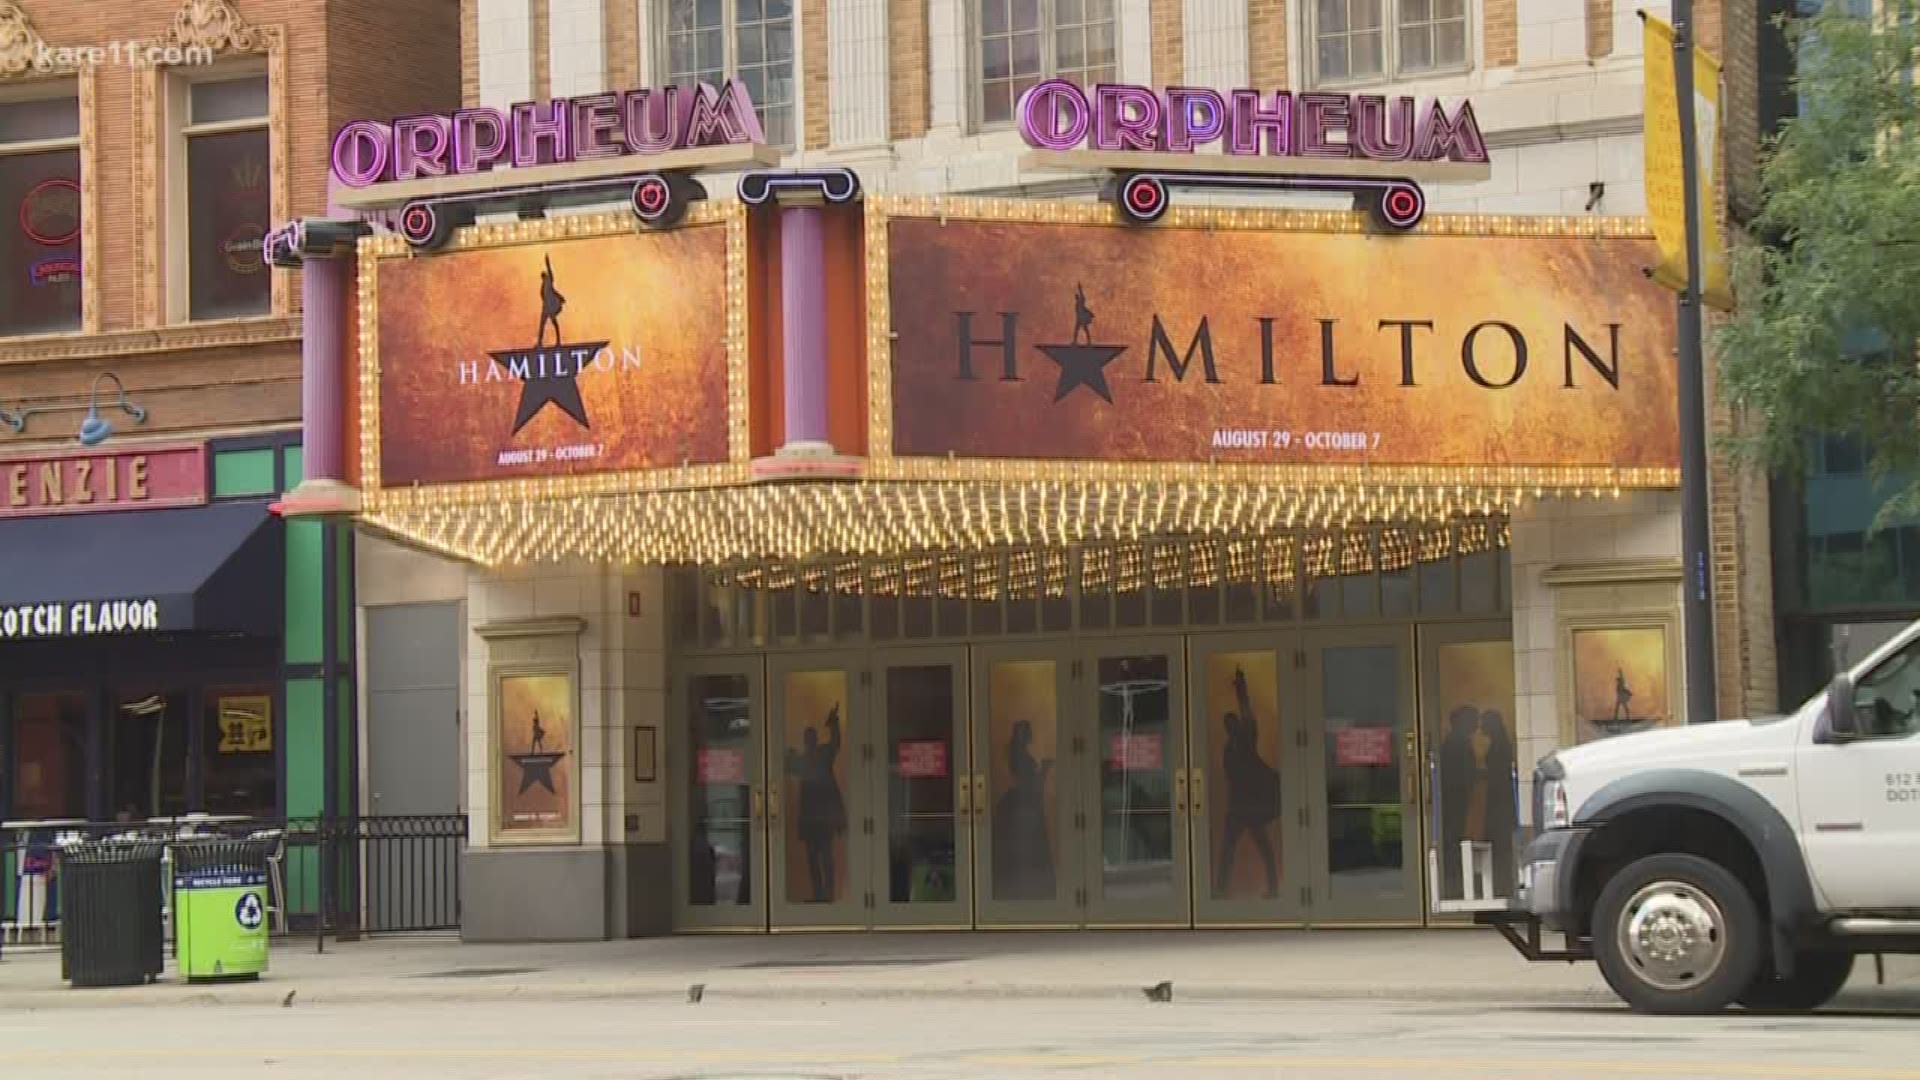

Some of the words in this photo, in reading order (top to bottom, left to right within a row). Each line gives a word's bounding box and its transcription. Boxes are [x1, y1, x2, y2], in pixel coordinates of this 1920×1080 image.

[331, 78, 764, 187] ORPHEUM
[1017, 78, 1488, 164] ORPHEUM
[459, 345, 643, 385] HAMILTON
[498, 449, 533, 466] AUGUST
[555, 444, 595, 461] OCTOBER
[1212, 430, 1269, 449] AUGUST
[1272, 431, 1291, 449] 29
[1305, 431, 1367, 450] OCTOBER
[1372, 432, 1381, 450] 7
[9, 455, 148, 506] ENZIE
[0, 604, 62, 638] OTCH
[70, 599, 158, 634] FLAVOR
[1885, 773, 1911, 786] 612
[1885, 788, 1920, 803] DOT
